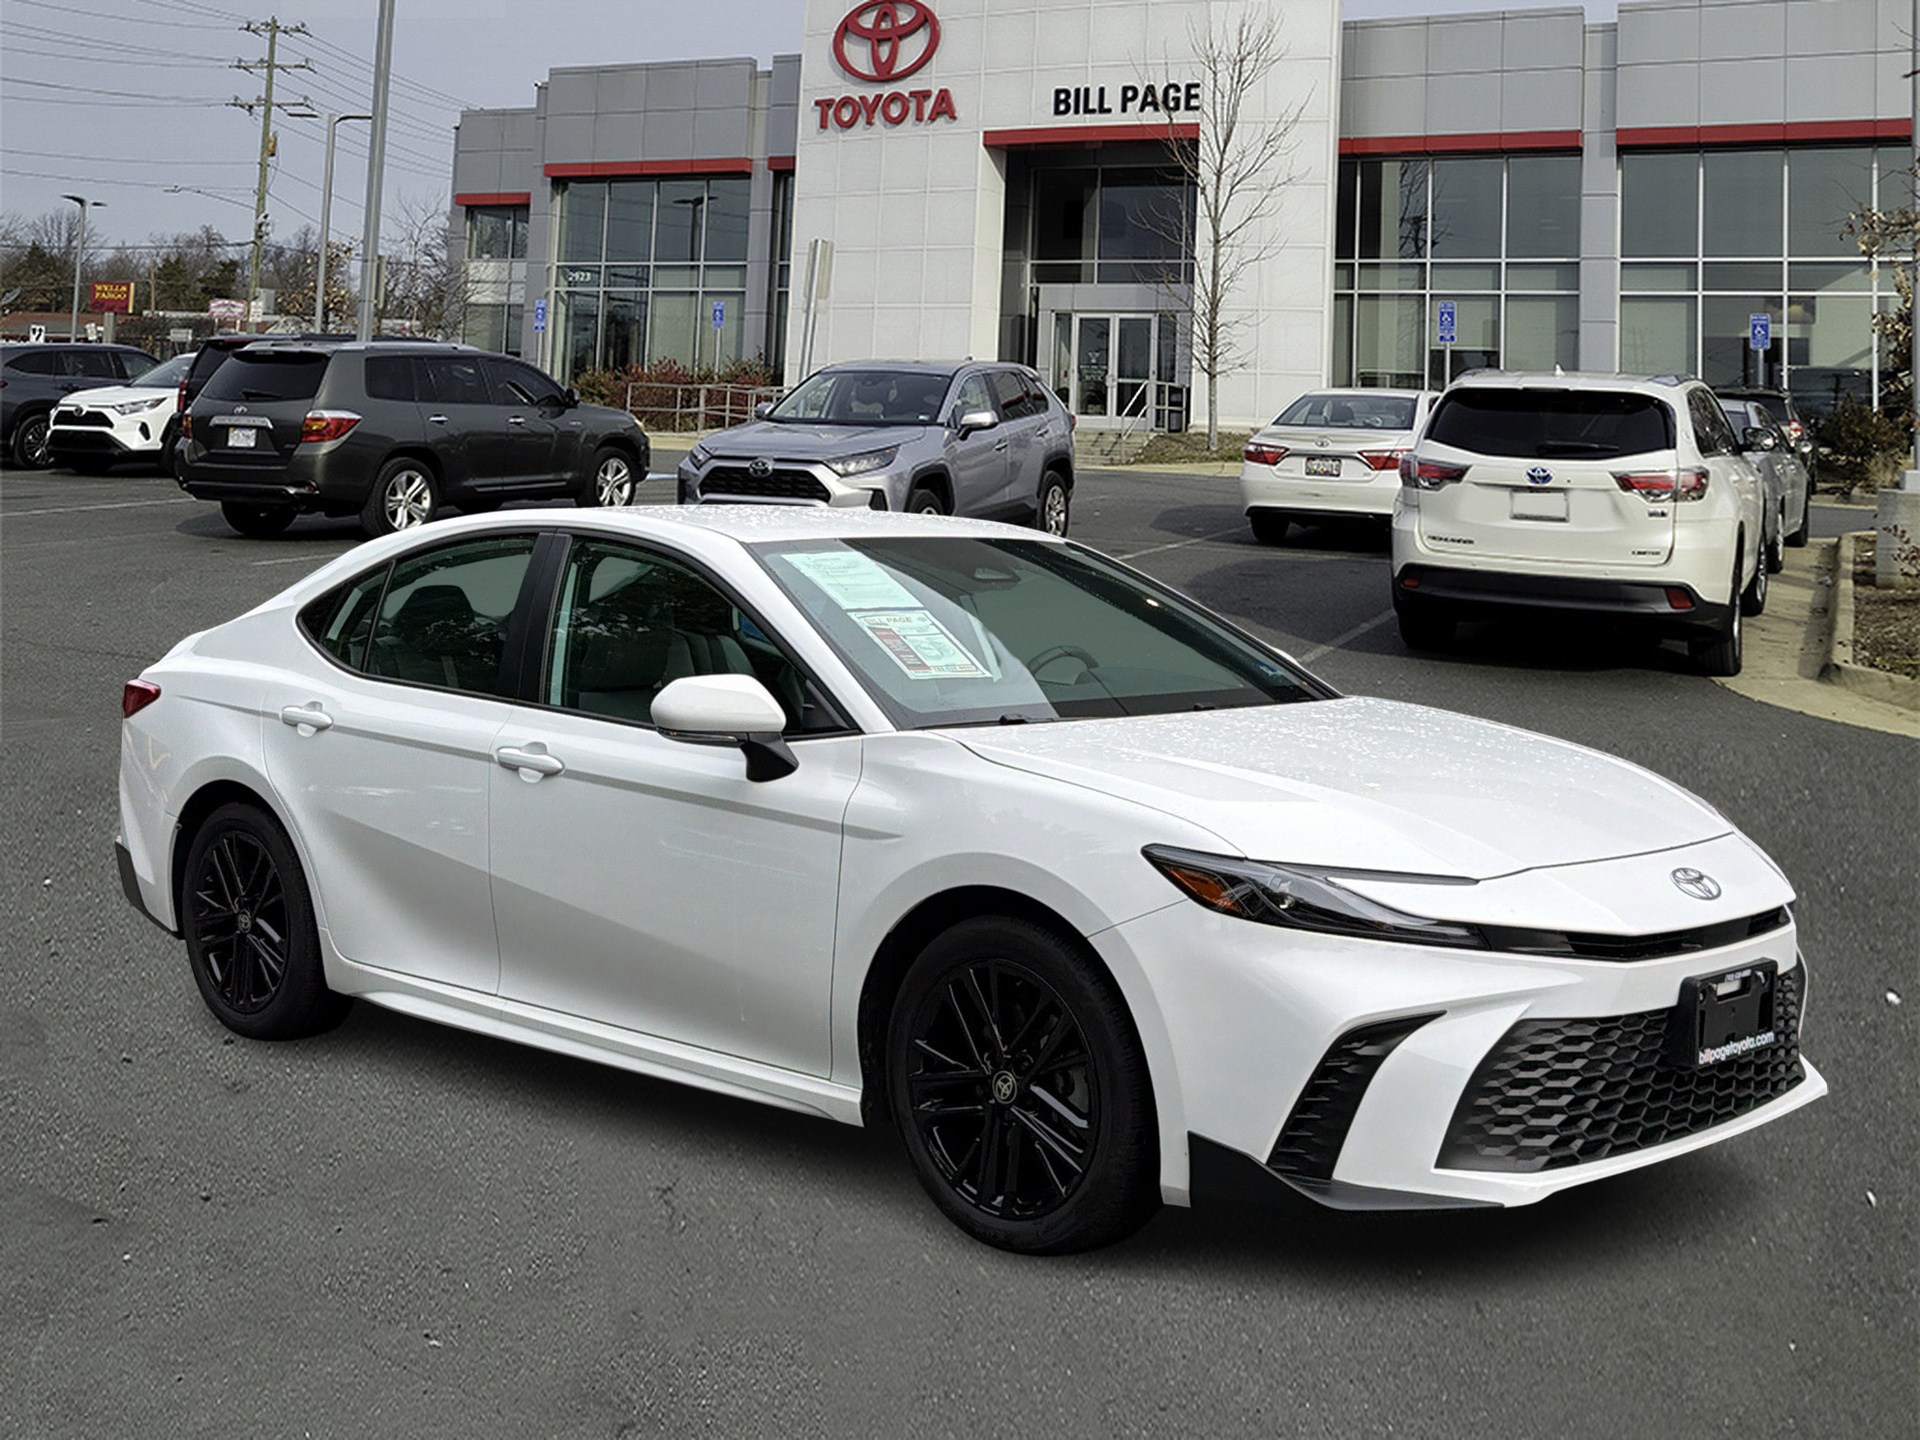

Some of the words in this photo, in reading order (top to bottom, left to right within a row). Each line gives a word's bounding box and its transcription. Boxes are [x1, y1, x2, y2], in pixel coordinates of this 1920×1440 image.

[814, 88, 957, 129] TOYOTA
[1053, 86, 1112, 116] BILL
[1121, 82, 1201, 113] PAGE
[94, 283, 127, 291] WELLS
[95, 291, 127, 300] FARGO
[1699, 1031, 1774, 1065] billpagetoyota.com
